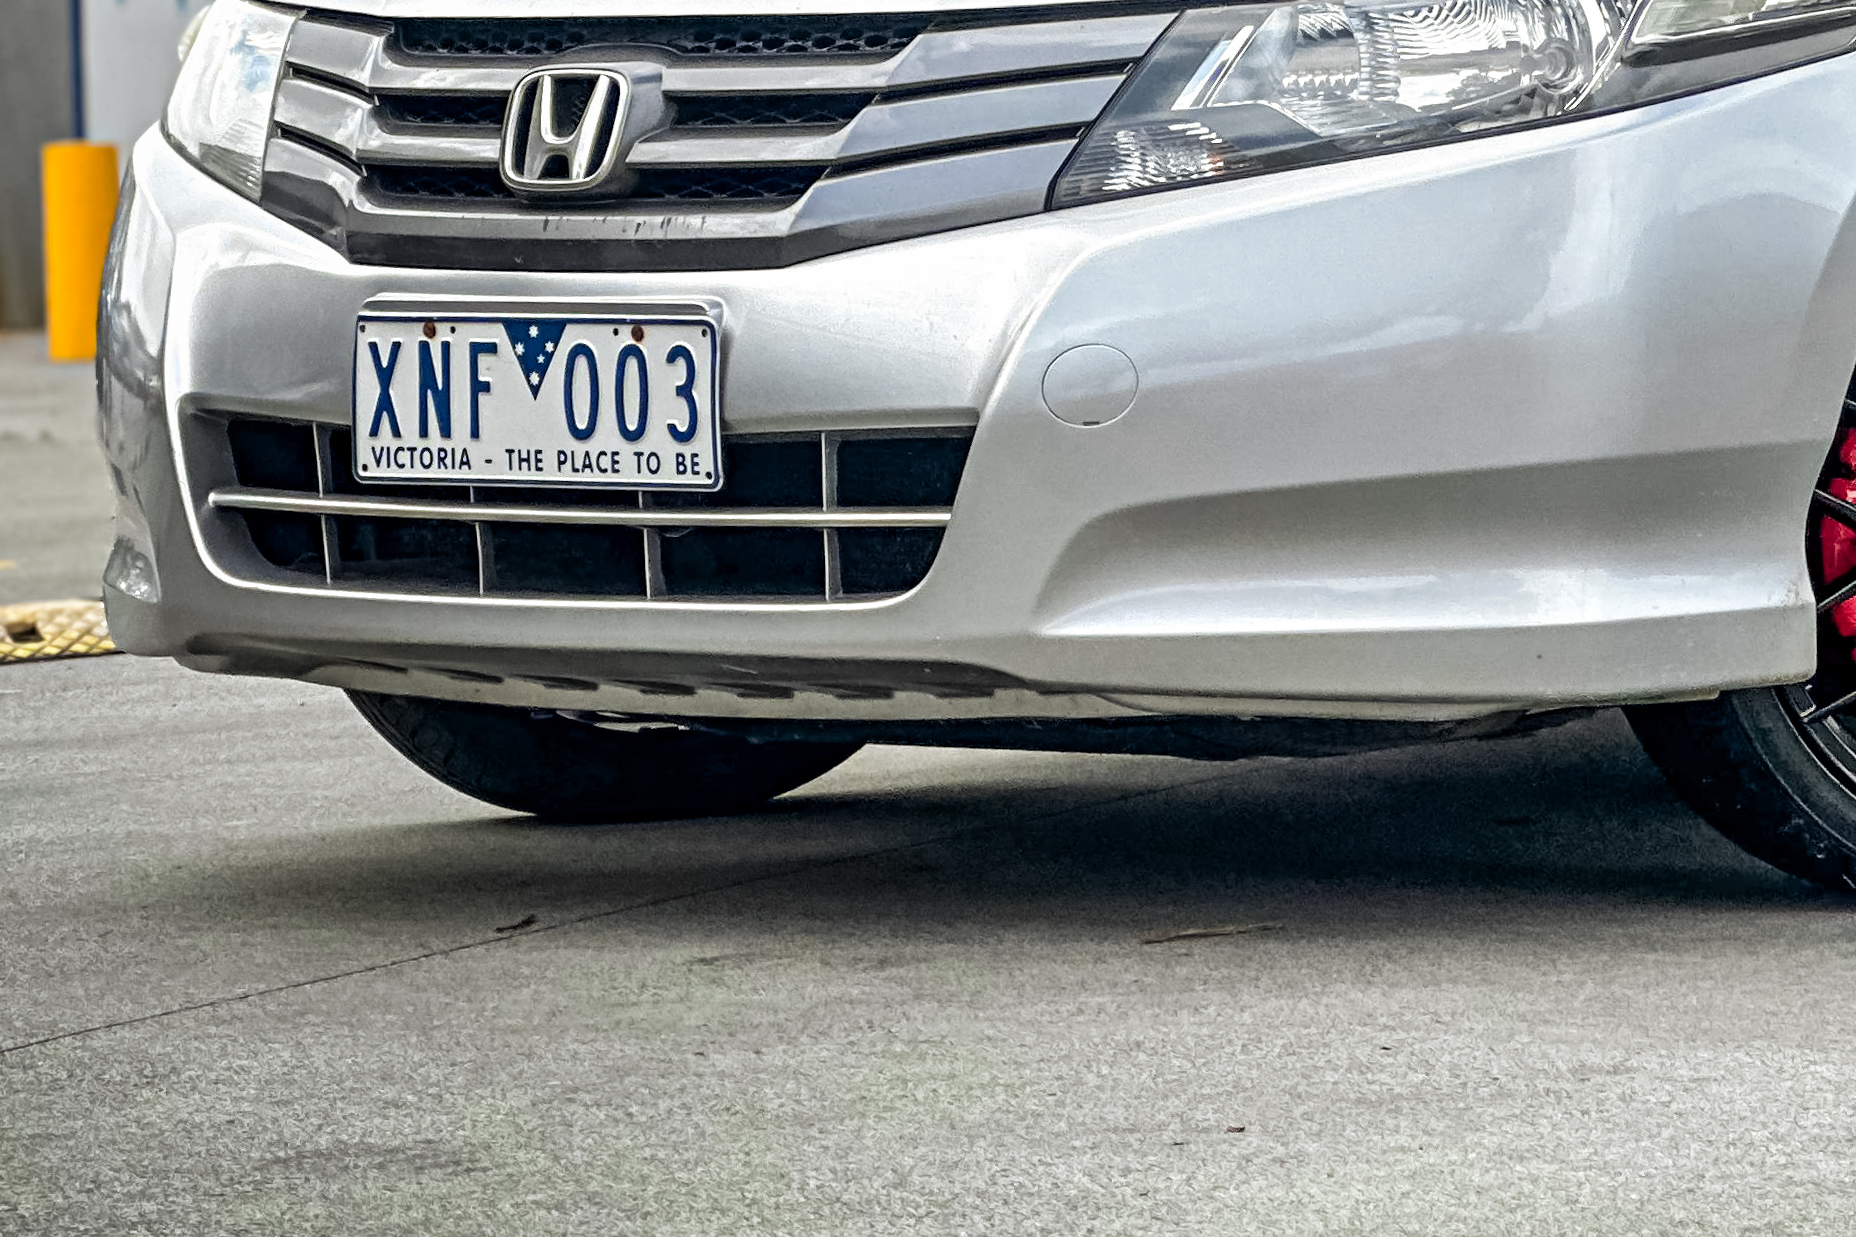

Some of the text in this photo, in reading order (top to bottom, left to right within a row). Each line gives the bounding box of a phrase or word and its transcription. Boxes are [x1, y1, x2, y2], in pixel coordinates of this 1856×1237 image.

[368, 339, 700, 443] XNF 003
[371, 446, 472, 470] VICTORIA
[505, 448, 544, 472] THE
[557, 450, 621, 474] PLACE
[633, 451, 661, 475] TO
[676, 453, 701, 475] BE
